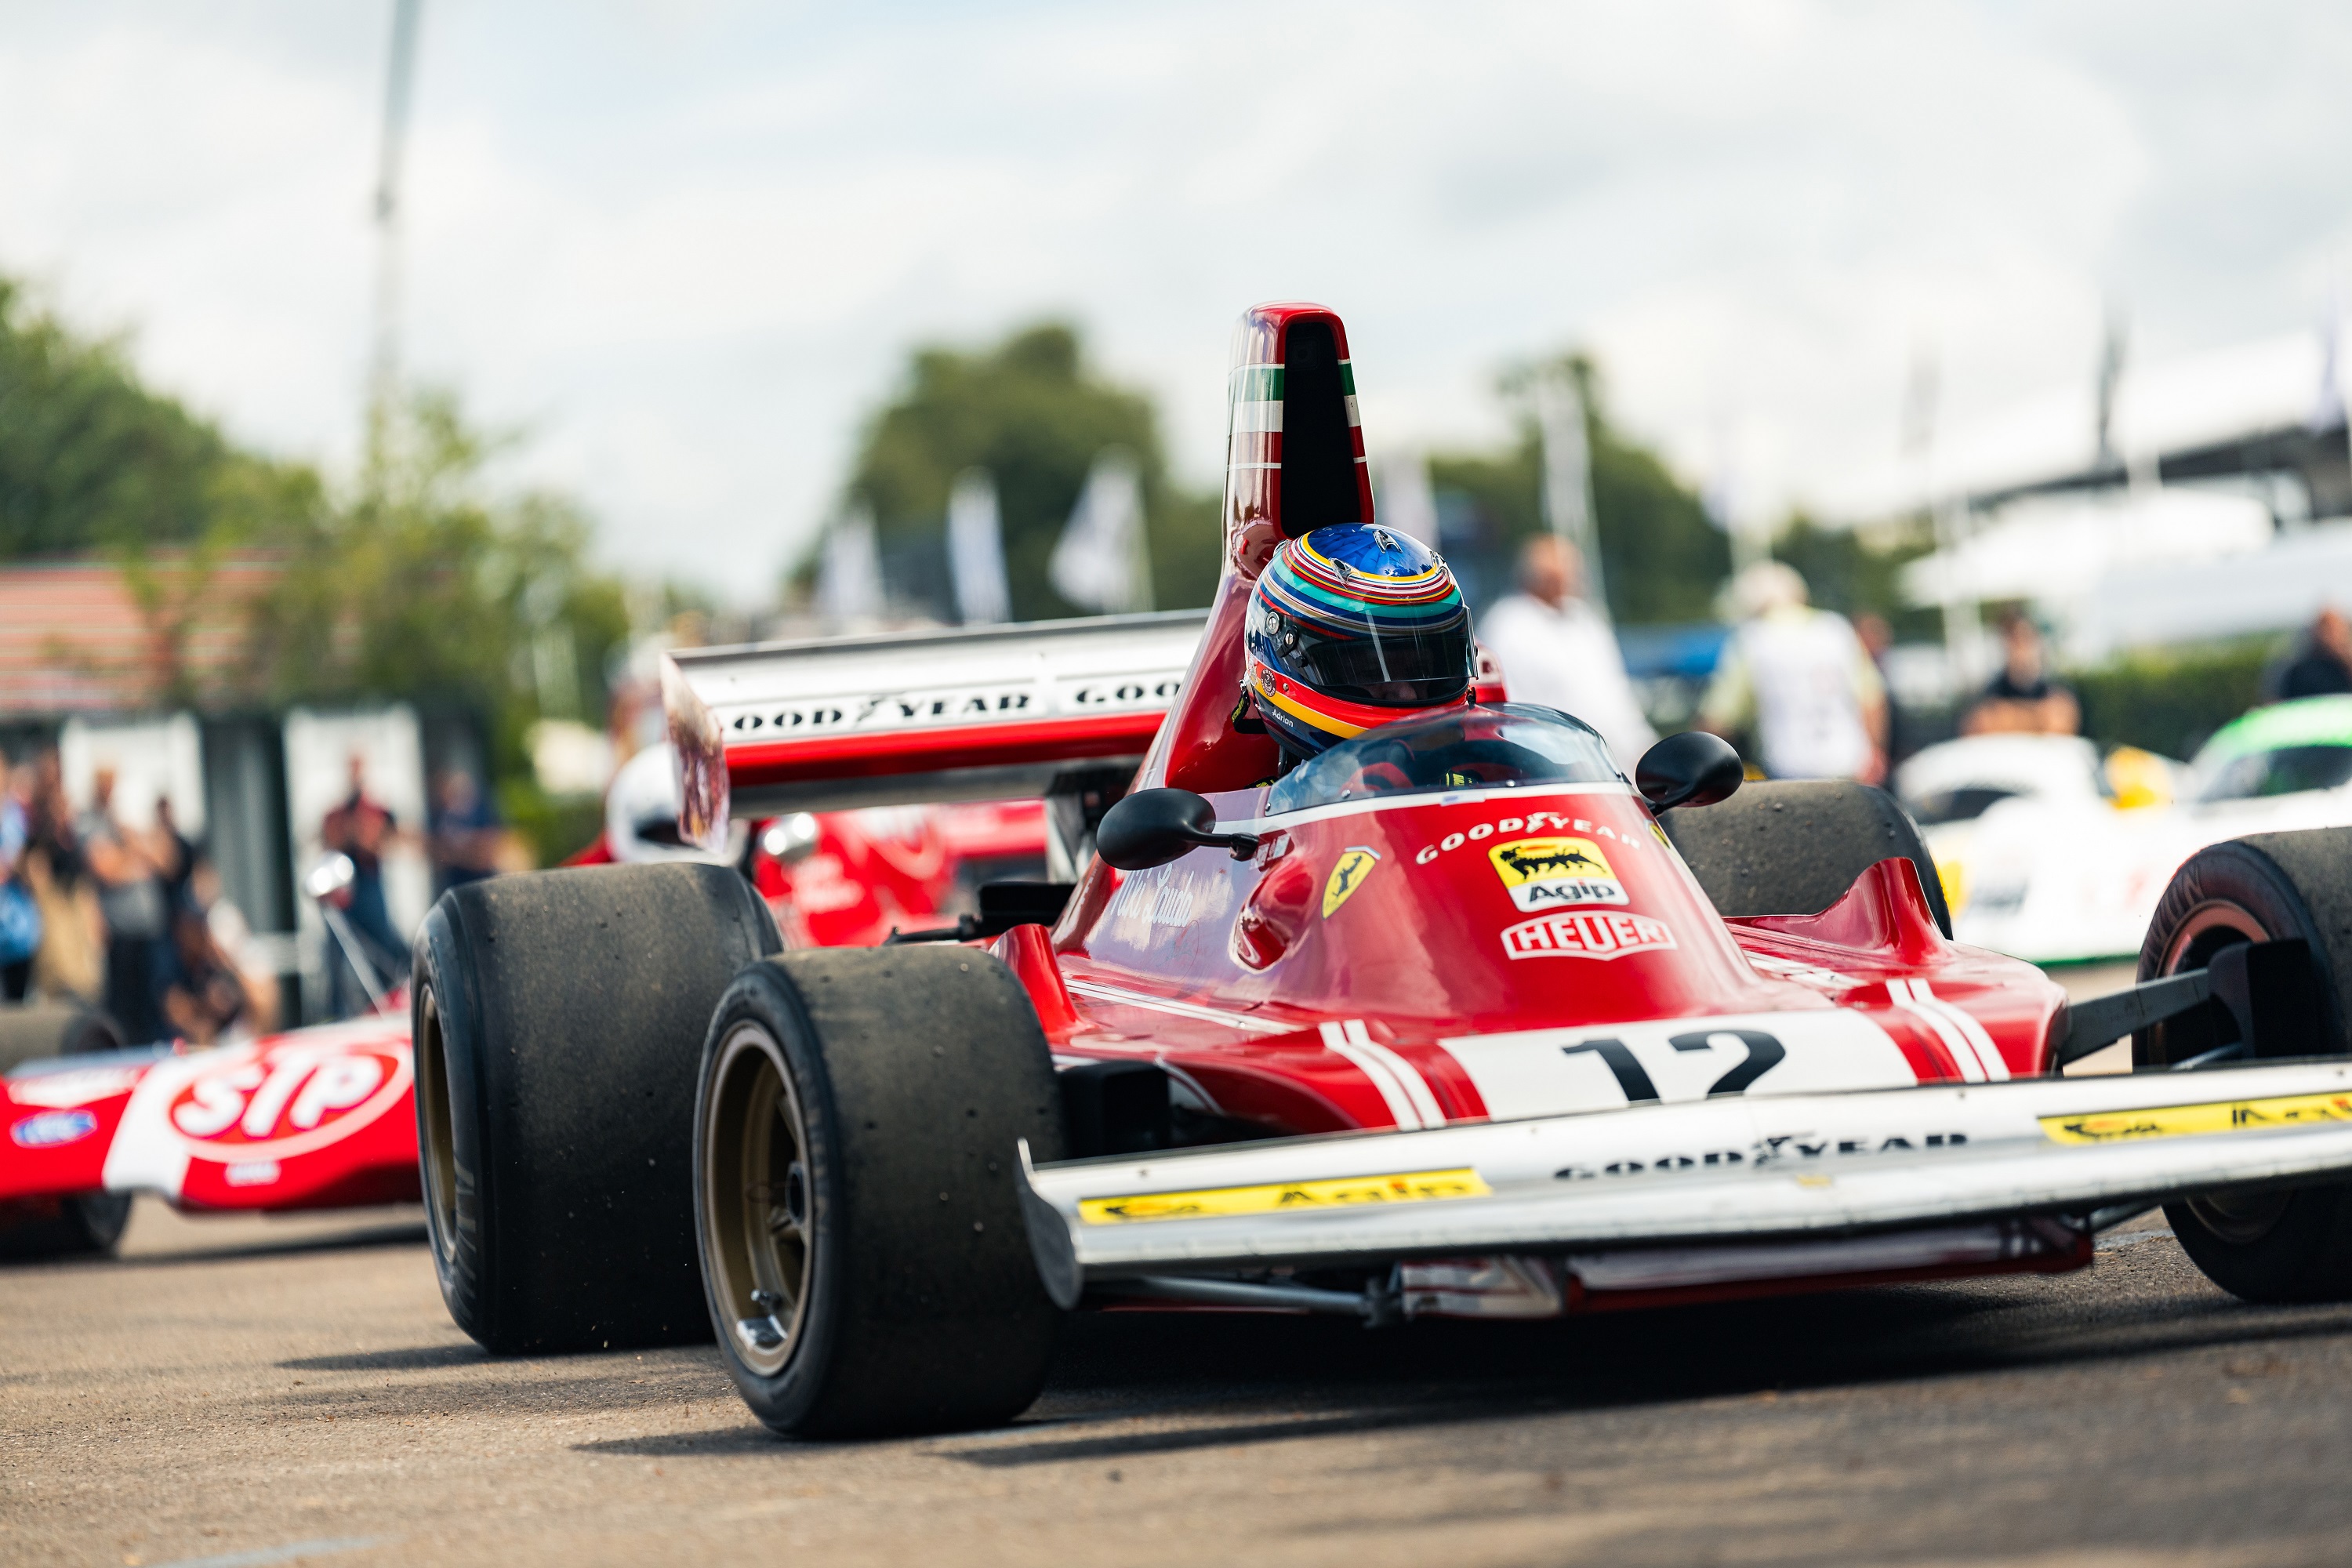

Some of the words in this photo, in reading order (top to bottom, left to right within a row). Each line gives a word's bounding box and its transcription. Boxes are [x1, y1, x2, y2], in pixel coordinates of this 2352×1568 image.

[734, 691, 1029, 731] OODYEAR
[1076, 683, 1182, 703] GOO
[1271, 709, 1294, 728] Adrian
[1415, 812, 1640, 865] GOODYEAR
[1142, 862, 1194, 927] Lauda
[1529, 878, 1615, 903] Agip
[1515, 916, 1664, 952] HEUER
[1561, 1029, 1787, 1102] 12
[172, 1049, 384, 1138] STP
[1553, 1131, 1969, 1179] GOODYEAR
